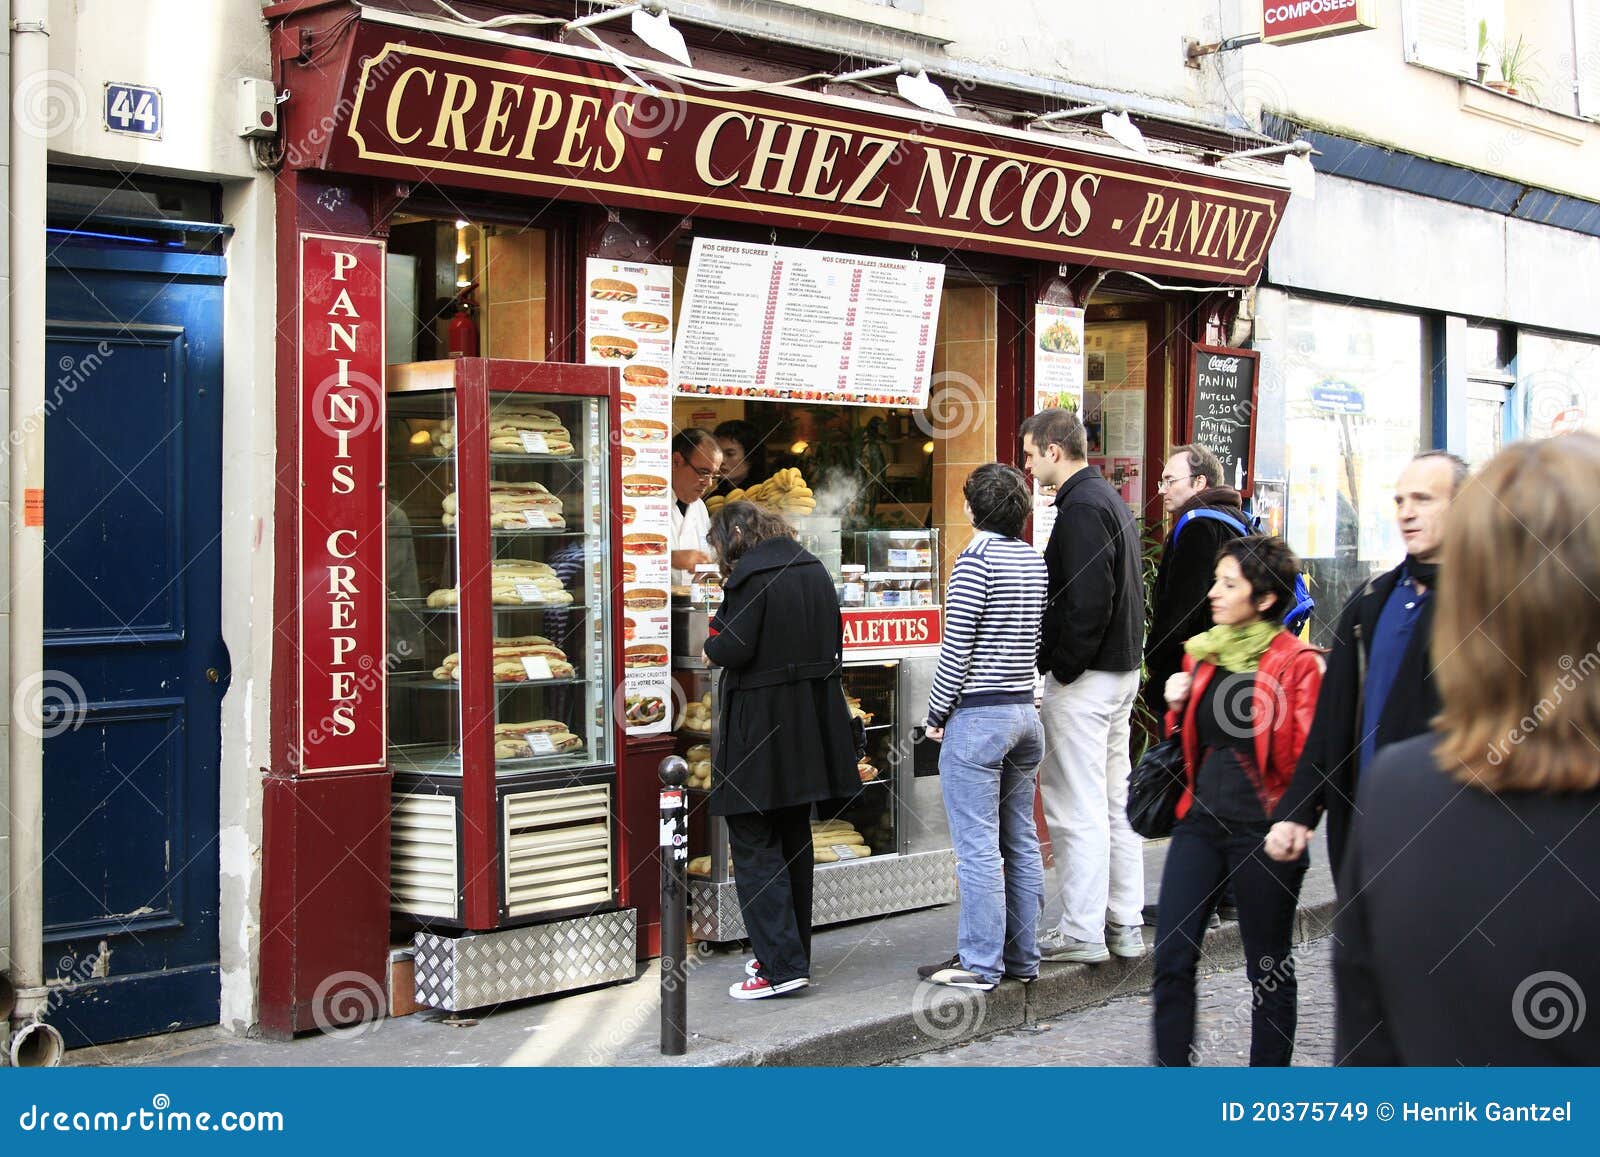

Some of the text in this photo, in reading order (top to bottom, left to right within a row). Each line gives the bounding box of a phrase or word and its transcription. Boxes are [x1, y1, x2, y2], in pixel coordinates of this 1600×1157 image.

[110, 90, 156, 131] 44
[386, 66, 635, 173] CREPES
[694, 111, 902, 209] CHEZ
[905, 146, 1102, 238] NICOS
[1129, 192, 1263, 262] PANINI
[327, 251, 360, 494] PANINIS
[326, 529, 360, 736] CRÊPES
[842, 618, 928, 644] ALETTES
